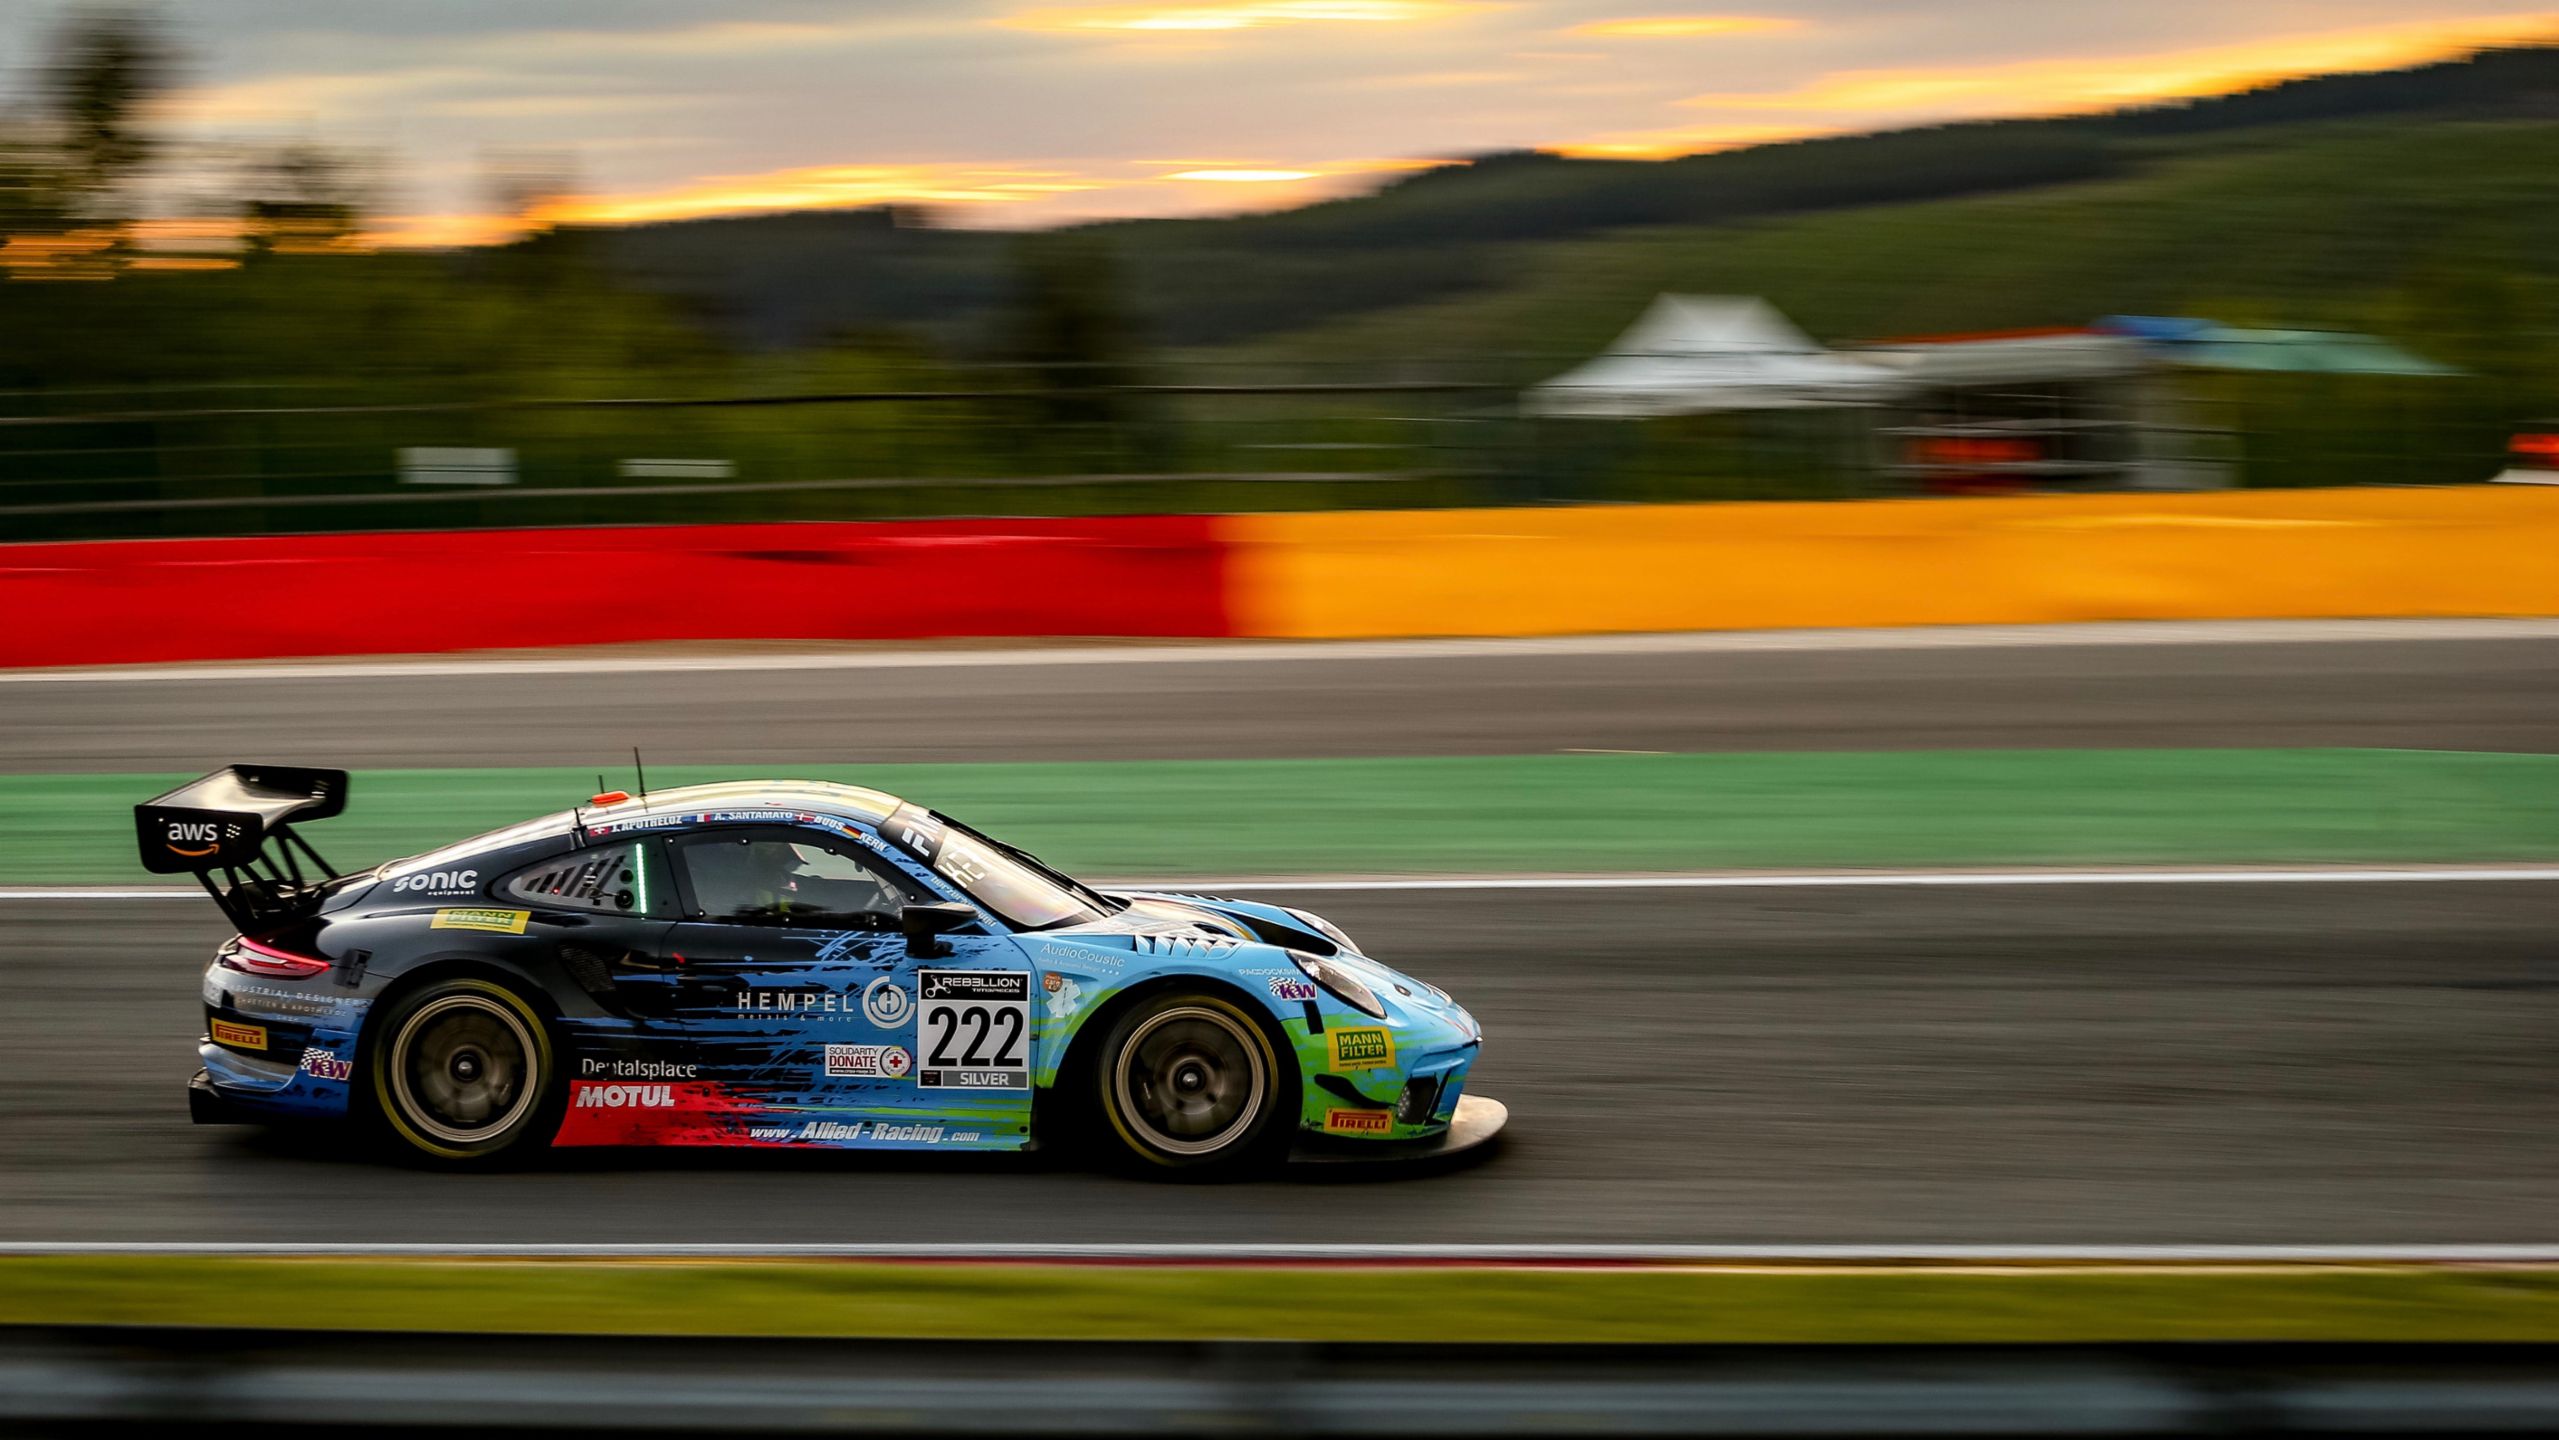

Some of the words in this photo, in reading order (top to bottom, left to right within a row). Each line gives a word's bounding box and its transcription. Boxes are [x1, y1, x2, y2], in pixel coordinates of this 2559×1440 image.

[168, 822, 218, 842] aws
[714, 812, 725, 821] A.
[729, 812, 793, 820] SANTAMATO
[859, 832, 887, 852] KERN
[452, 910, 512, 919] MANN
[1040, 943, 1126, 968] AudioCoustic
[943, 977, 1020, 988] REBELLION
[1280, 983, 1317, 1000] KW
[738, 992, 854, 1013] HEMPEL
[738, 1013, 788, 1021] metals
[215, 1023, 262, 1046] PIRELLI
[928, 1006, 1024, 1067] 222
[1340, 1033, 1382, 1046] MANN
[829, 1046, 879, 1055] SOLIDARITY
[1341, 1044, 1384, 1058] FILTER
[829, 1055, 877, 1067] DONATE
[309, 1060, 352, 1081] KW
[960, 1072, 1009, 1086] SILVER
[576, 1085, 675, 1108] MOTUL
[1330, 1111, 1389, 1130] PIRELLI
